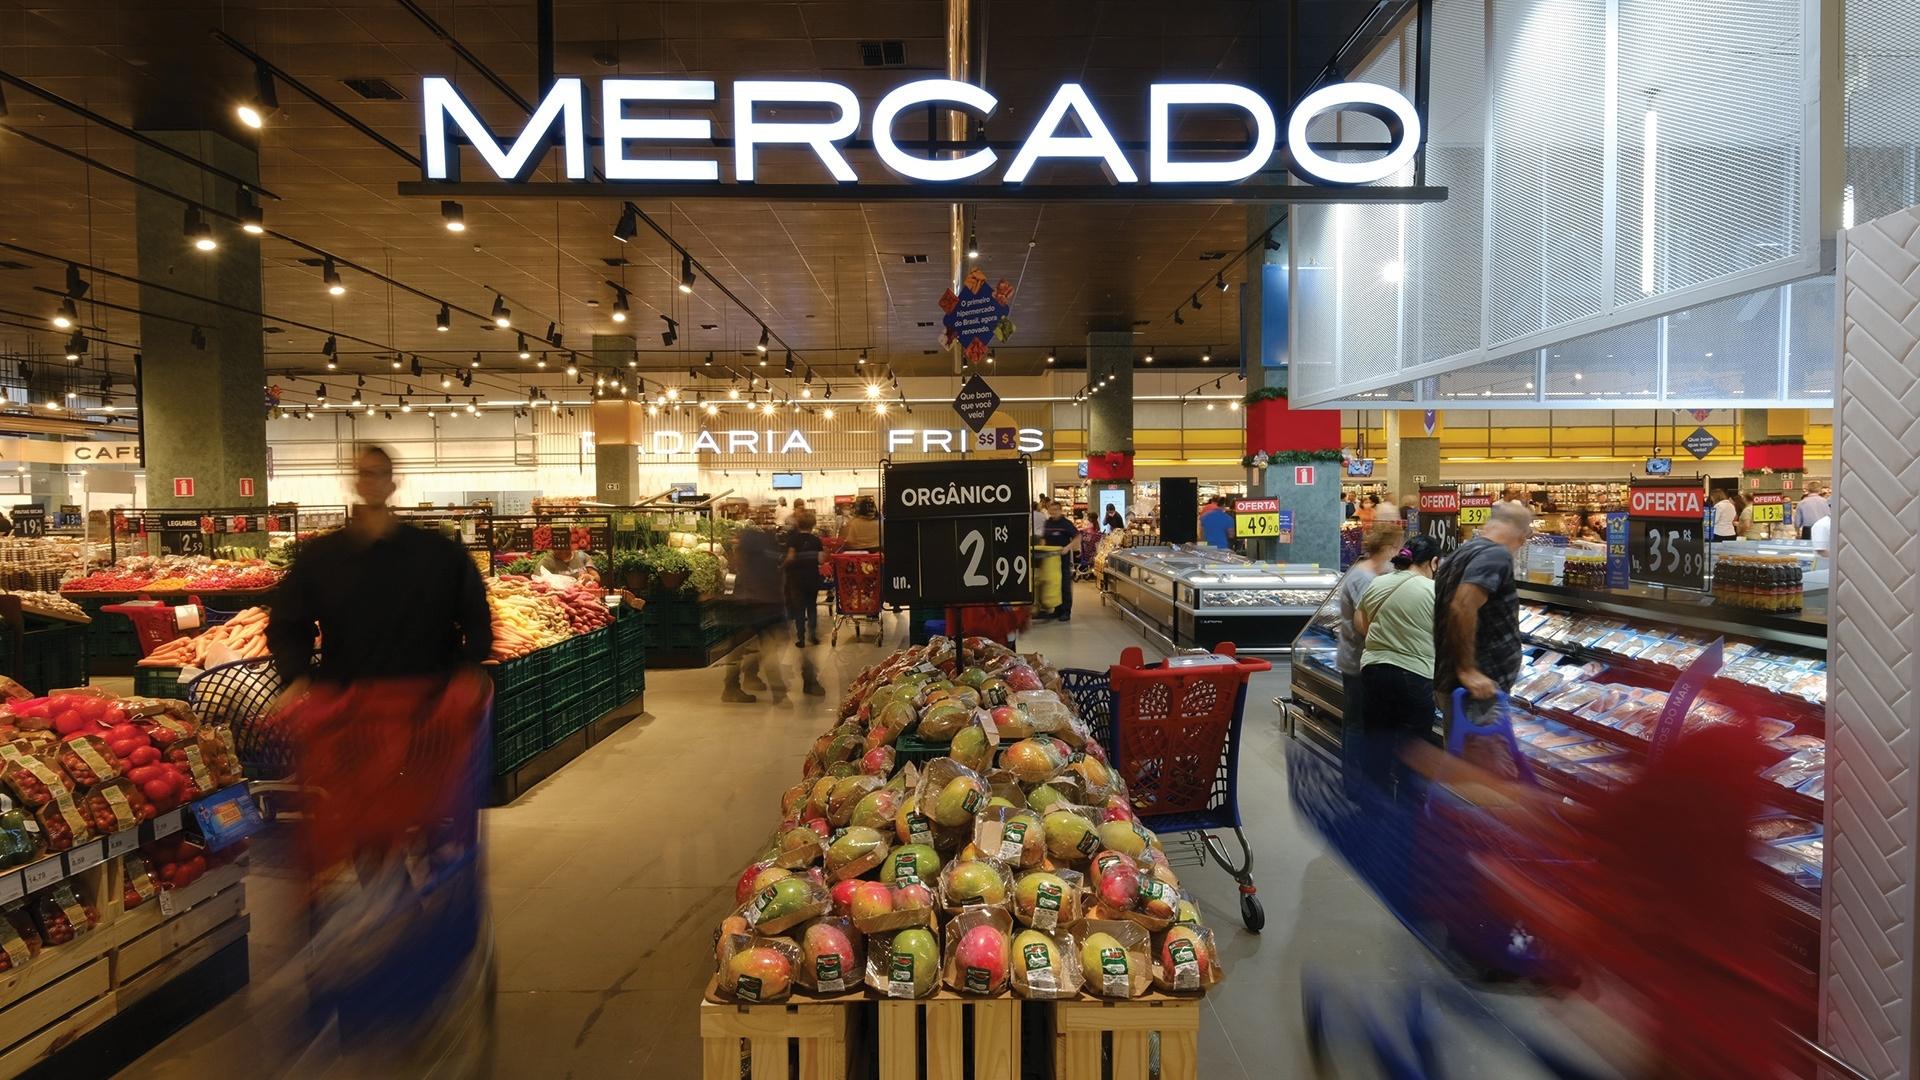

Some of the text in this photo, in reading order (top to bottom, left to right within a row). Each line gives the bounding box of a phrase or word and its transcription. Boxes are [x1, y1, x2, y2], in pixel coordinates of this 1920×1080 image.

[422, 76, 1421, 183] MERCADO
[967, 297, 991, 307] primeiro
[956, 305, 996, 317] hipermercado
[963, 317, 981, 325] Brasil,
[981, 315, 998, 324] agora
[961, 326, 990, 335] renovado.
[960, 391, 992, 401] Que bom
[960, 400, 992, 412] que você
[968, 410, 985, 419] veio!
[582, 430, 813, 455] DARIA
[888, 428, 1044, 453] FRIS
[901, 481, 1012, 507] ORGÂNICO
[1420, 494, 1457, 508] OFERTA
[1753, 495, 1782, 503] OFERTA
[1237, 501, 1277, 511] OFERTA
[1632, 492, 1700, 512] OFERTA
[1468, 509, 1483, 522] 39
[1762, 506, 1774, 520] 13
[167, 519, 198, 527] LEGUMES
[1247, 516, 1267, 535] 49
[182, 533, 193, 552] 2
[1609, 544, 1626, 554] FAZ
[959, 529, 989, 587] 2
[994, 525, 1009, 543] R$
[1649, 528, 1681, 573] 35
[893, 575, 911, 590] un.
[1664, 707, 1678, 725] DO
[1673, 682, 1691, 706] MAR
